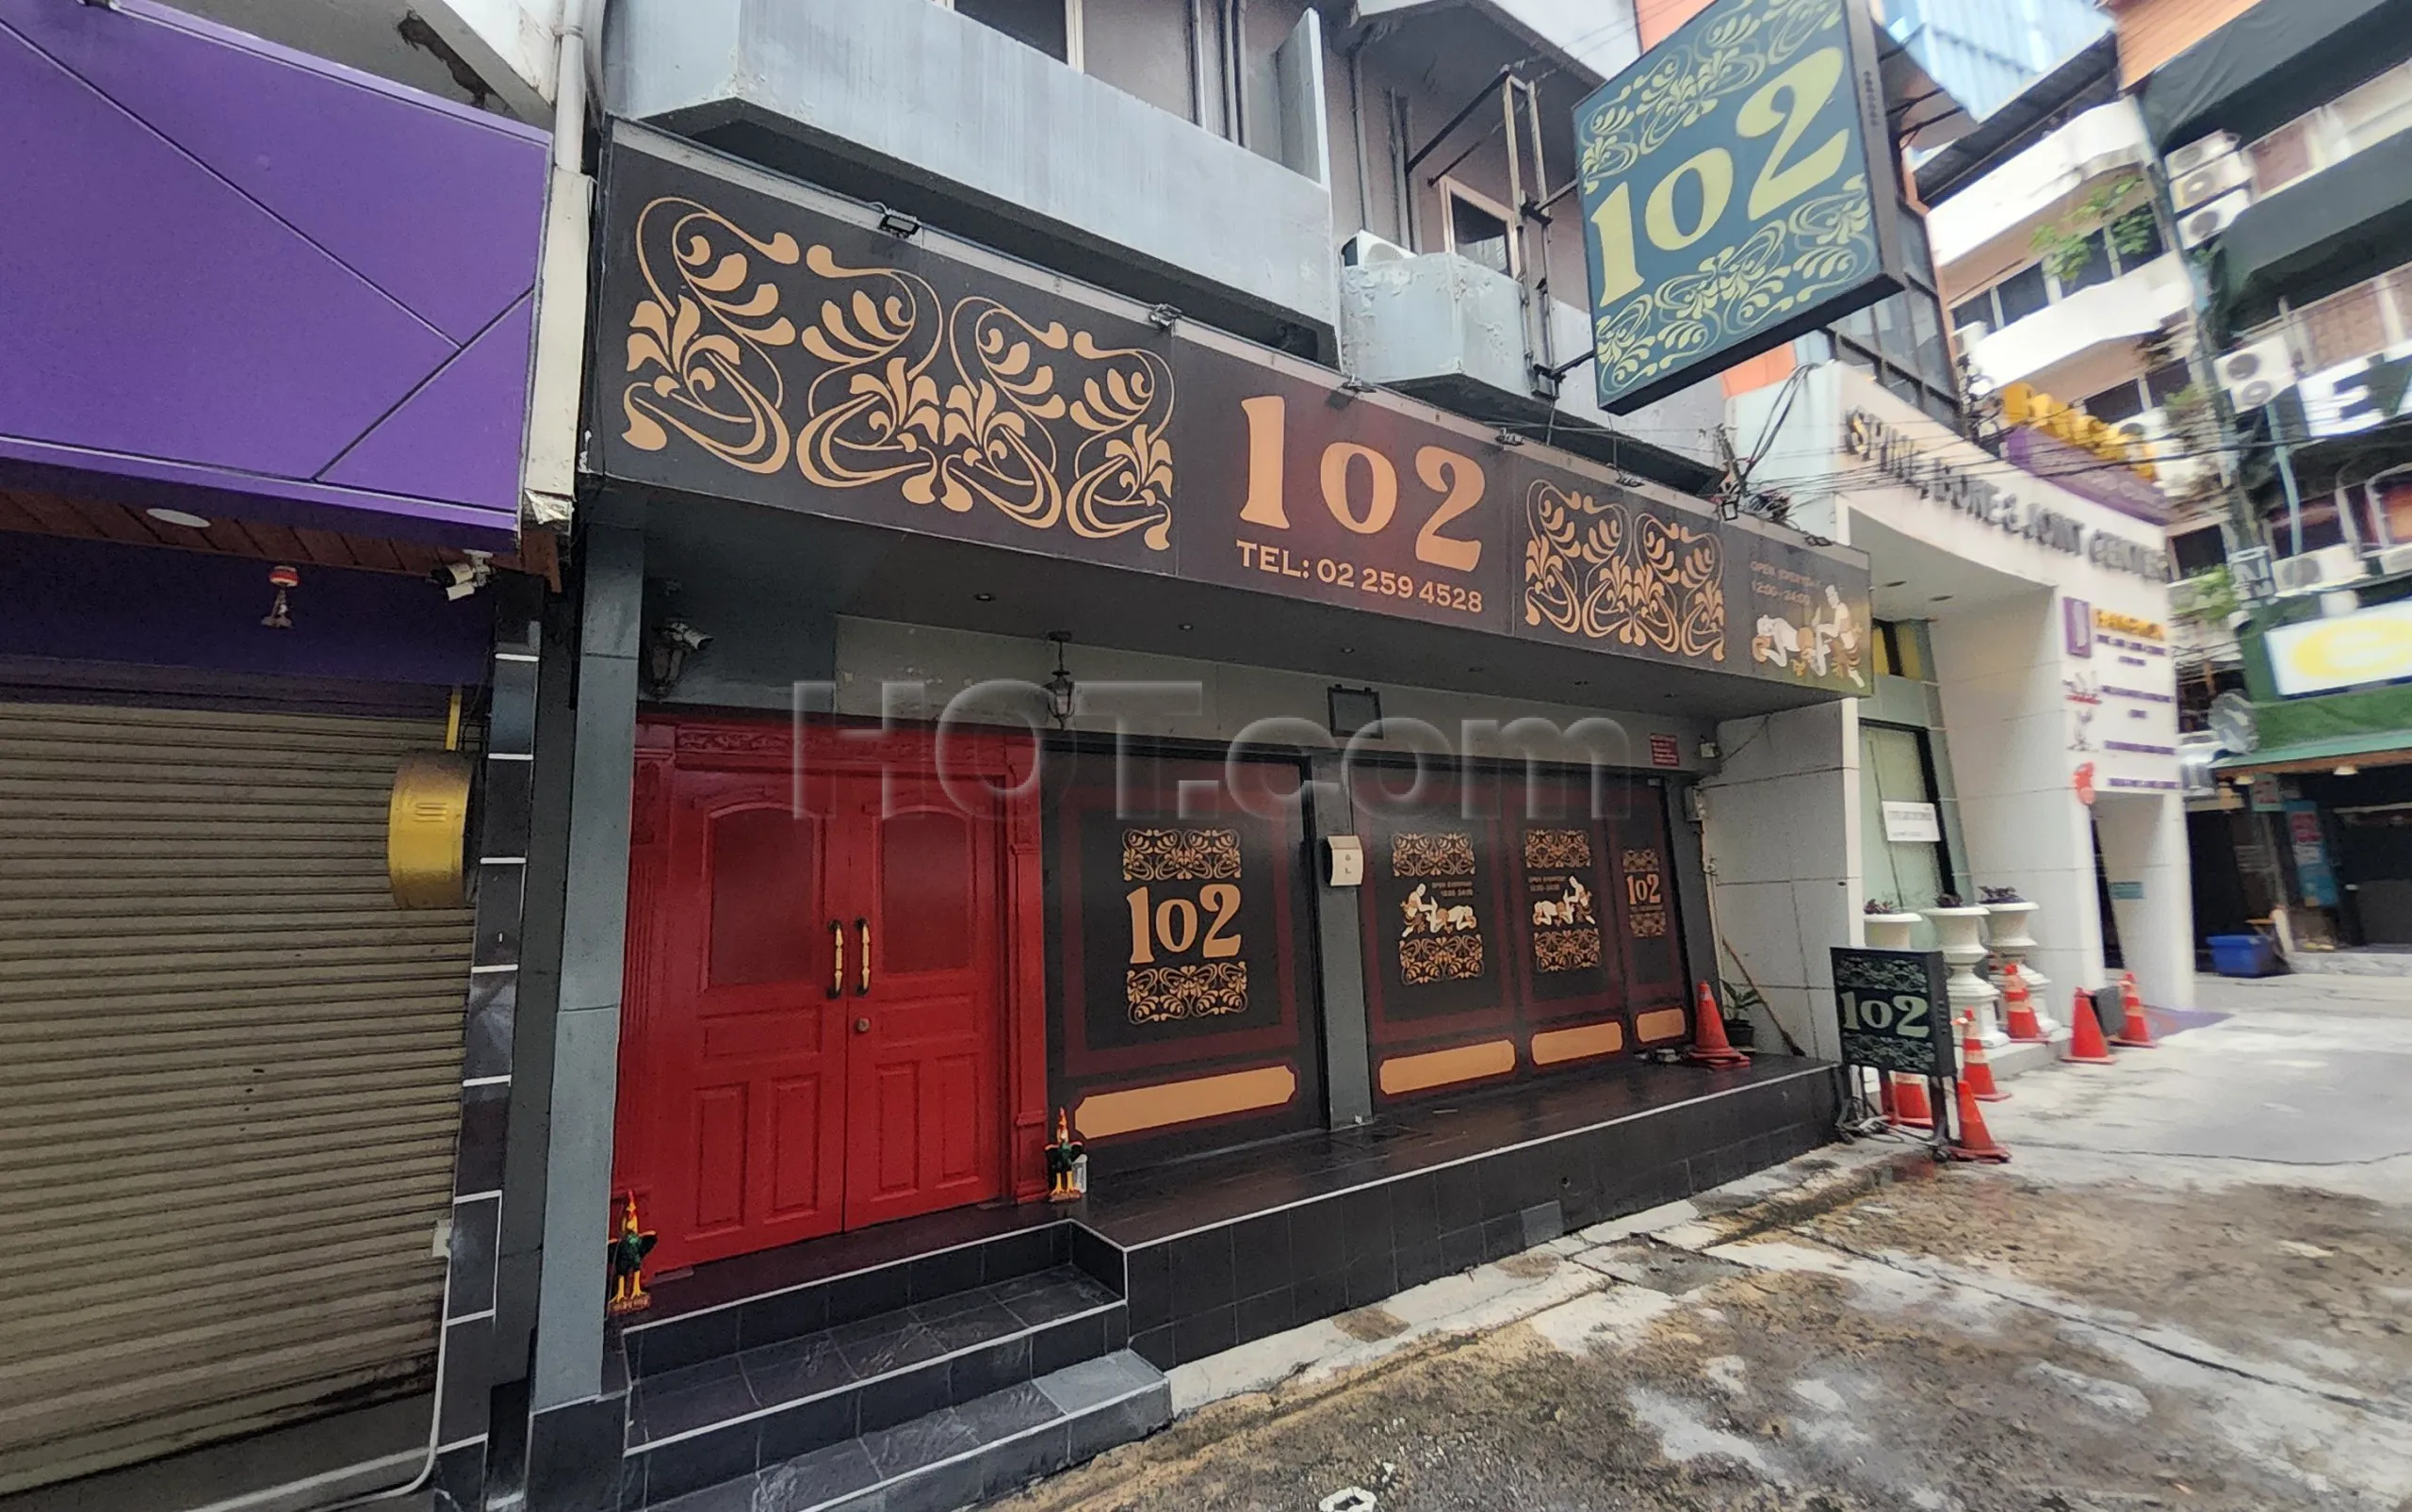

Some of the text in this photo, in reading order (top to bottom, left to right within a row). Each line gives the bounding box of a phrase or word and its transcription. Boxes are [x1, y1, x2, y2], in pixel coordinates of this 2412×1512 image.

[1590, 47, 1850, 307] 102
[1240, 396, 1485, 573] 102
[1236, 540, 1482, 612] TEL: 02 259 4528
[1127, 884, 1241, 964] 102
[1626, 874, 1661, 904] 102
[1840, 991, 1930, 1037] 102
